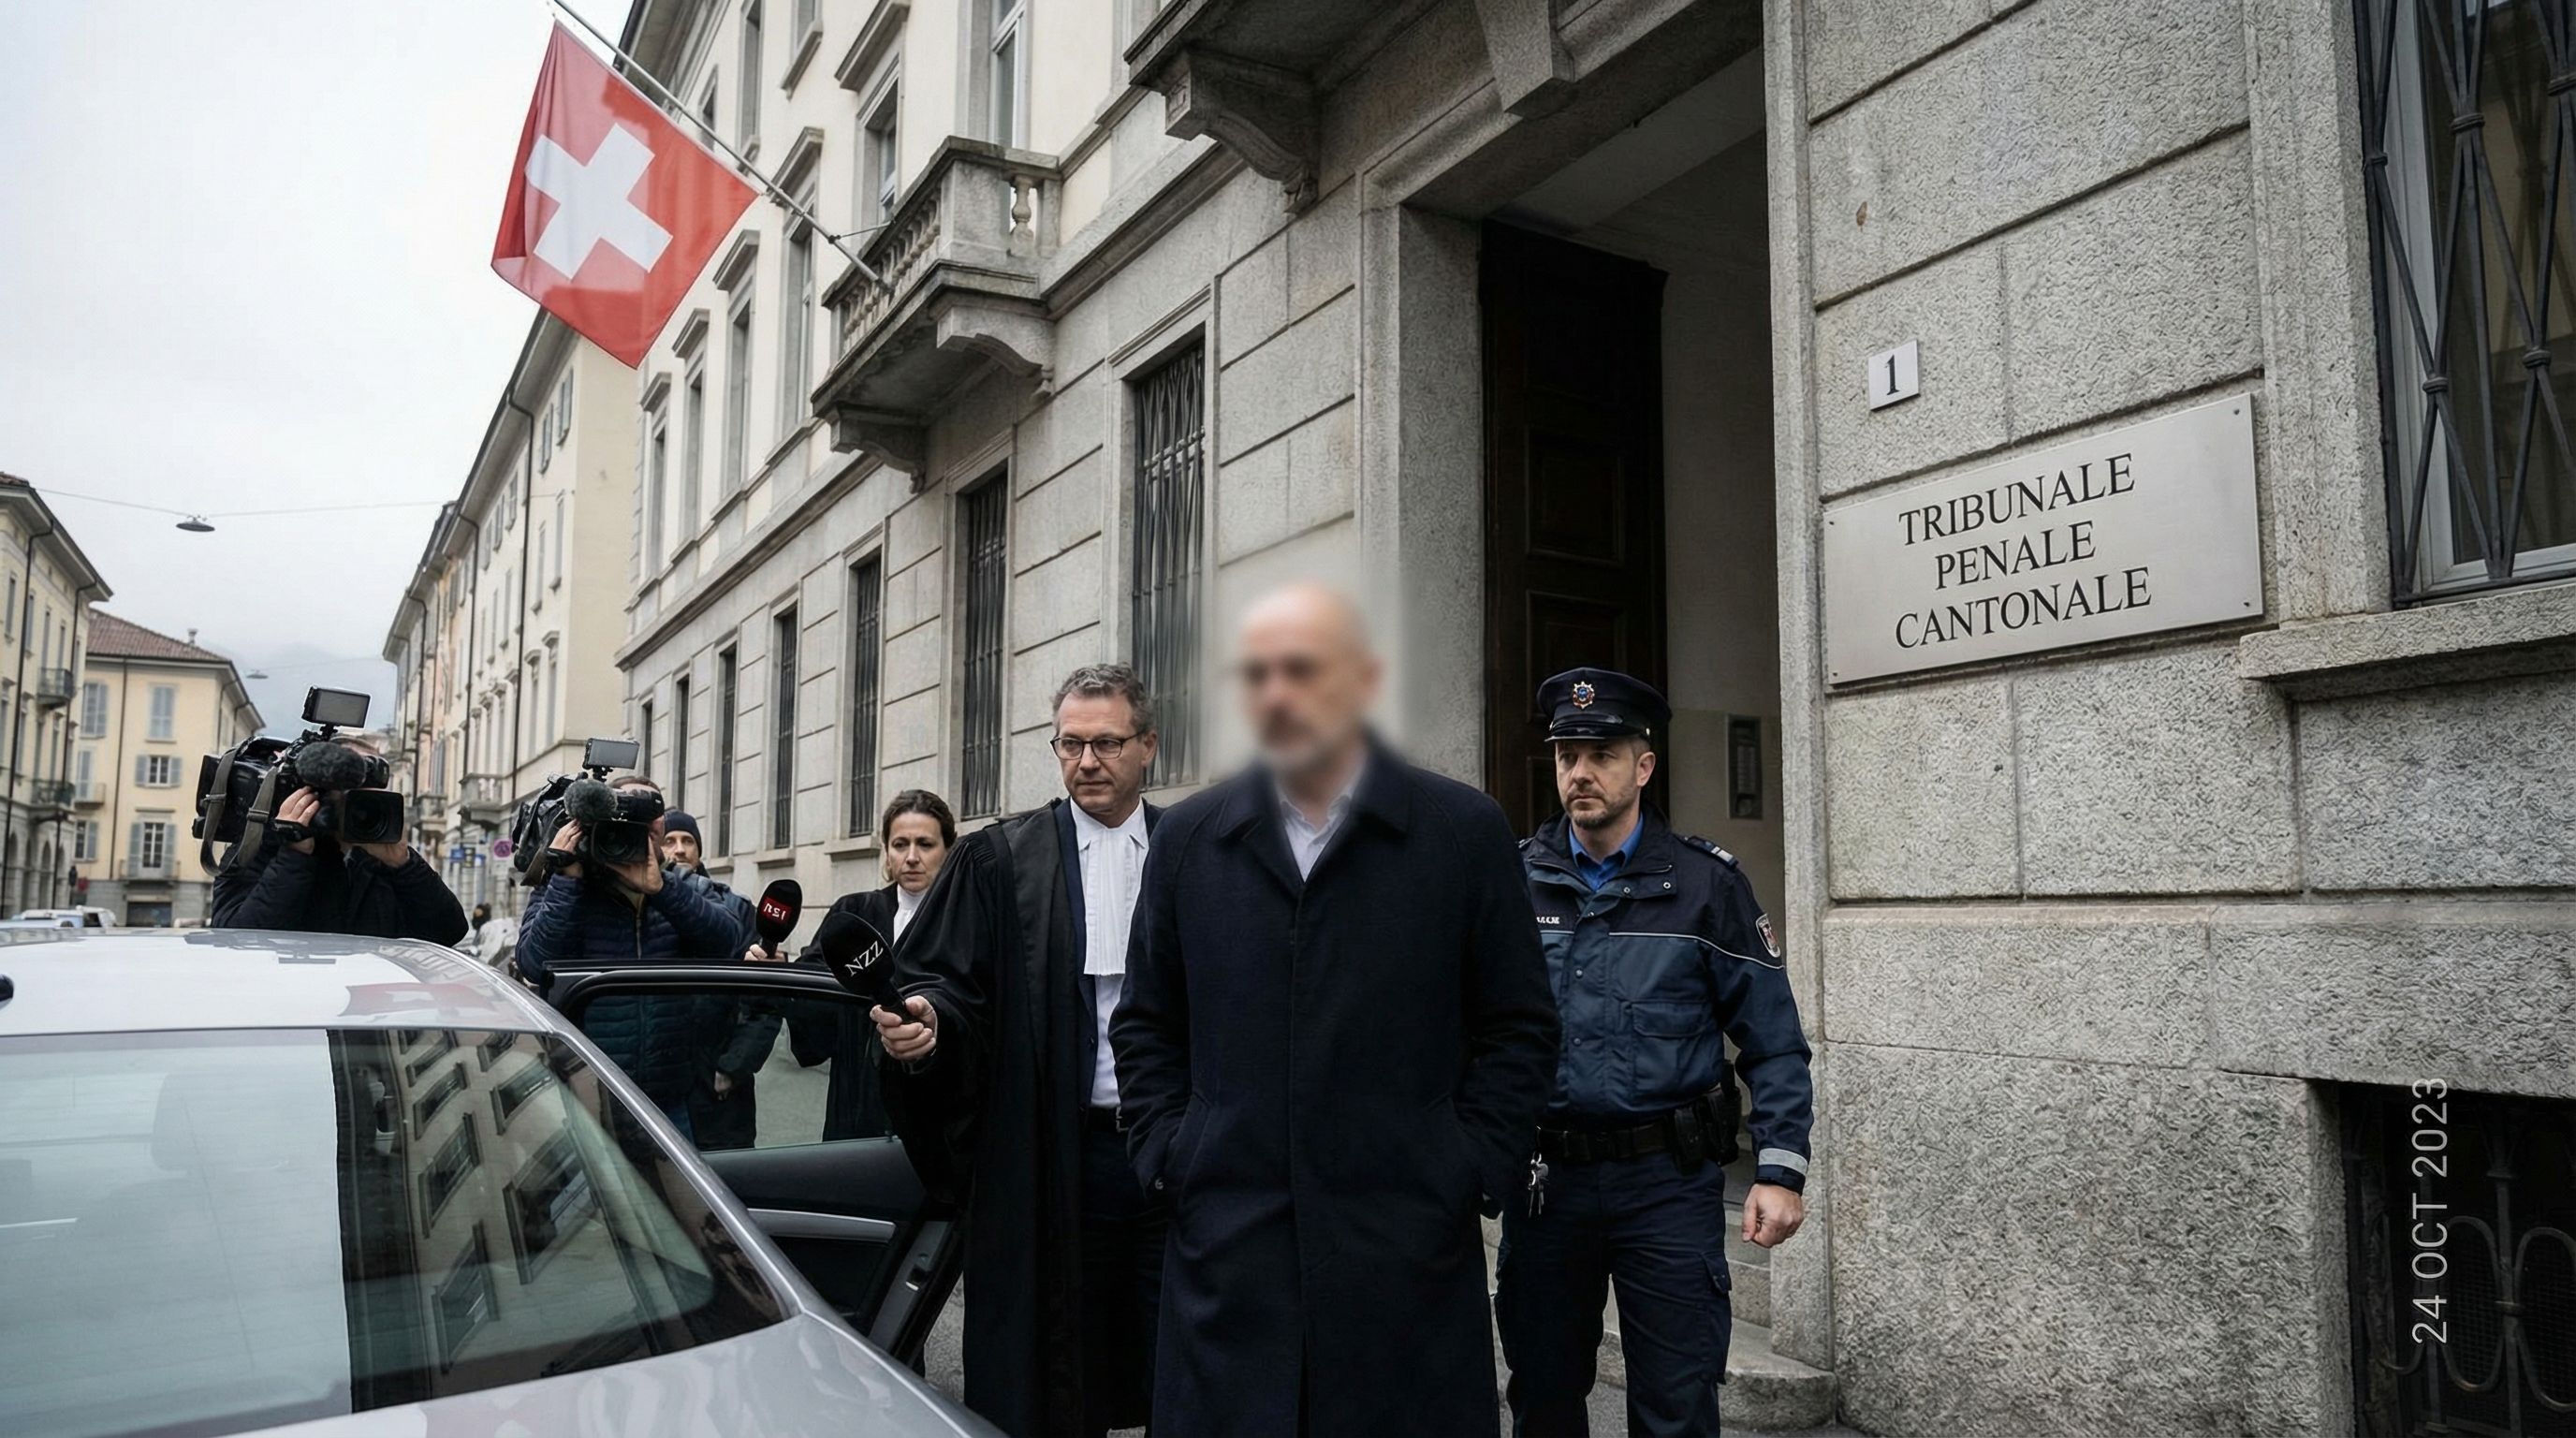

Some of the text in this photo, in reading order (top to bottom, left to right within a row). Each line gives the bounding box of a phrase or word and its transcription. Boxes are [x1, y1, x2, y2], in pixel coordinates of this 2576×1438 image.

[1884, 355, 1900, 396] 1
[1898, 452, 2135, 546] TRIBUNALE
[1935, 520, 2096, 591] PENALE
[1895, 566, 2152, 649] CANTONALE
[844, 940, 884, 976] NZZ
